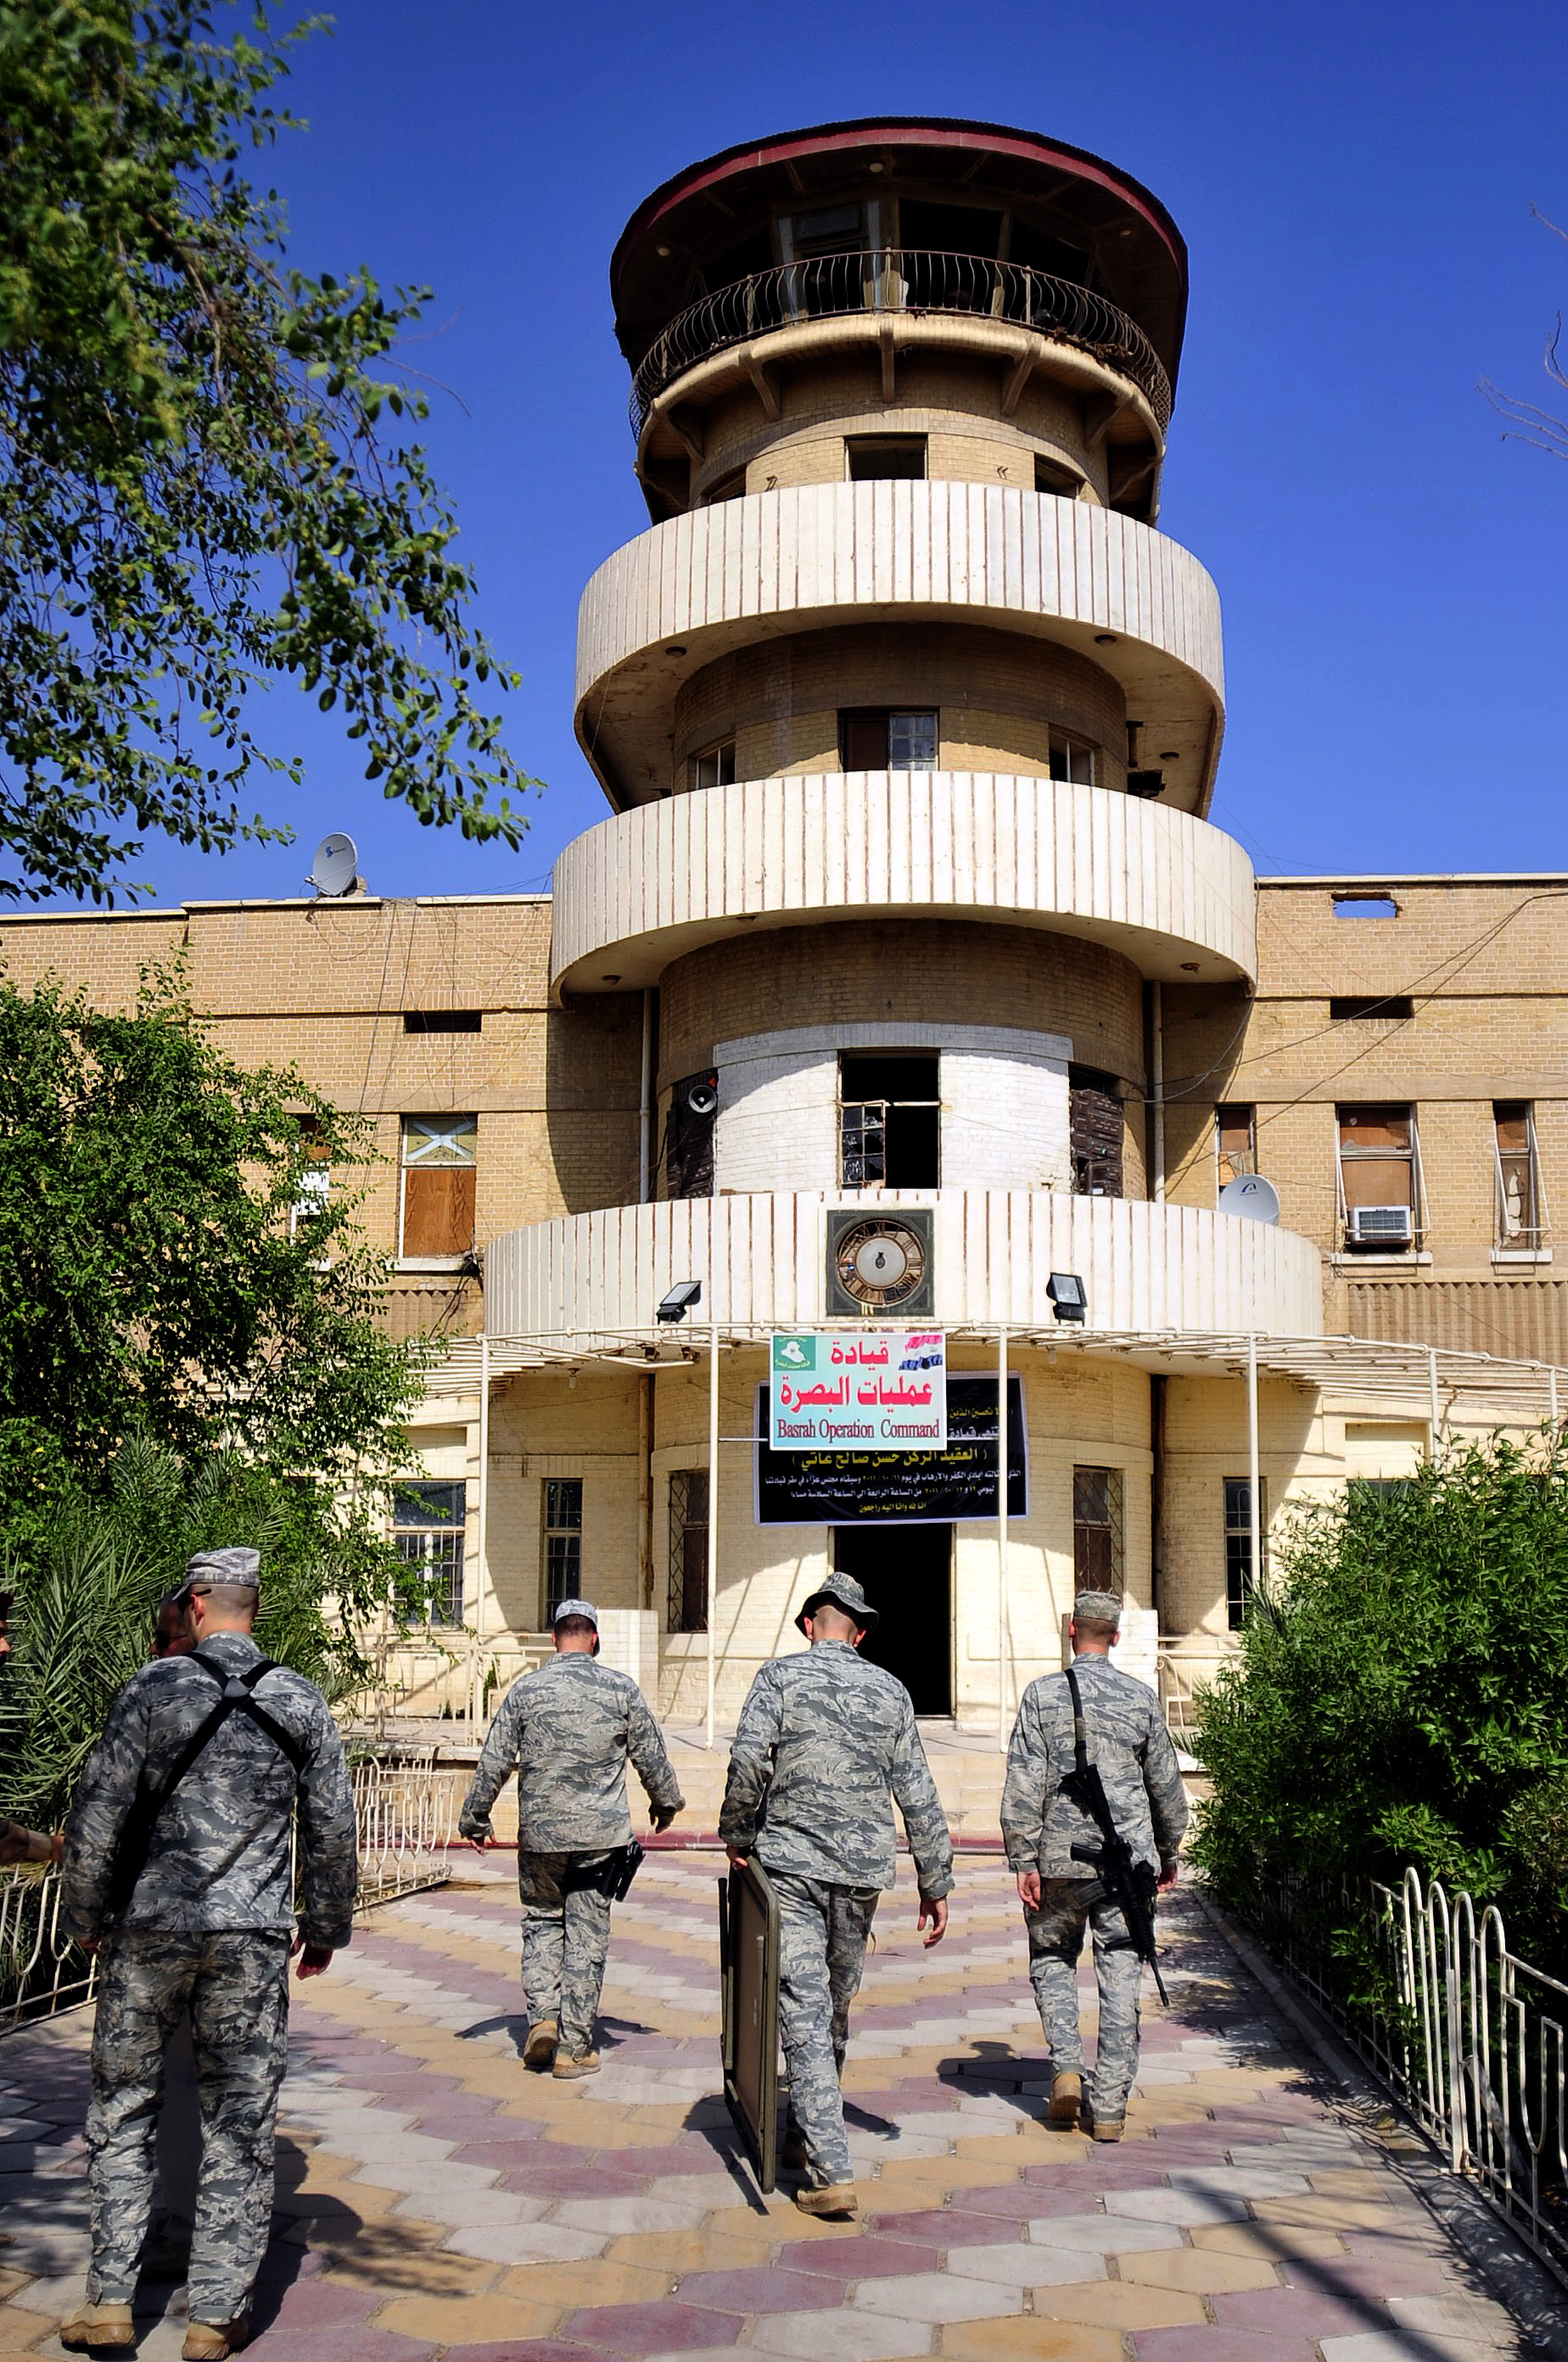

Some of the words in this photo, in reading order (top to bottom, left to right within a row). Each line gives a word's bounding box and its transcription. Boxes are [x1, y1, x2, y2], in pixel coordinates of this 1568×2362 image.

[831, 1341, 889, 1371] قيادة
[781, 1374, 850, 1413] البصرة
[857, 1374, 932, 1413] عمليات
[777, 1419, 816, 1438] Basrah
[819, 1419, 875, 1443] Operation
[881, 1419, 939, 1438] Command
[835, 1452, 869, 1469] صالح
[872, 1452, 899, 1467] حسن
[904, 1450, 938, 1466] الركن
[940, 1447, 978, 1464] العقيد
[901, 1475, 912, 1483] يوم
[913, 1472, 920, 1484] في
[834, 1488, 855, 1497] الساعة
[867, 1487, 889, 1498] الرابعة
[890, 1487, 913, 1496] الساعة
